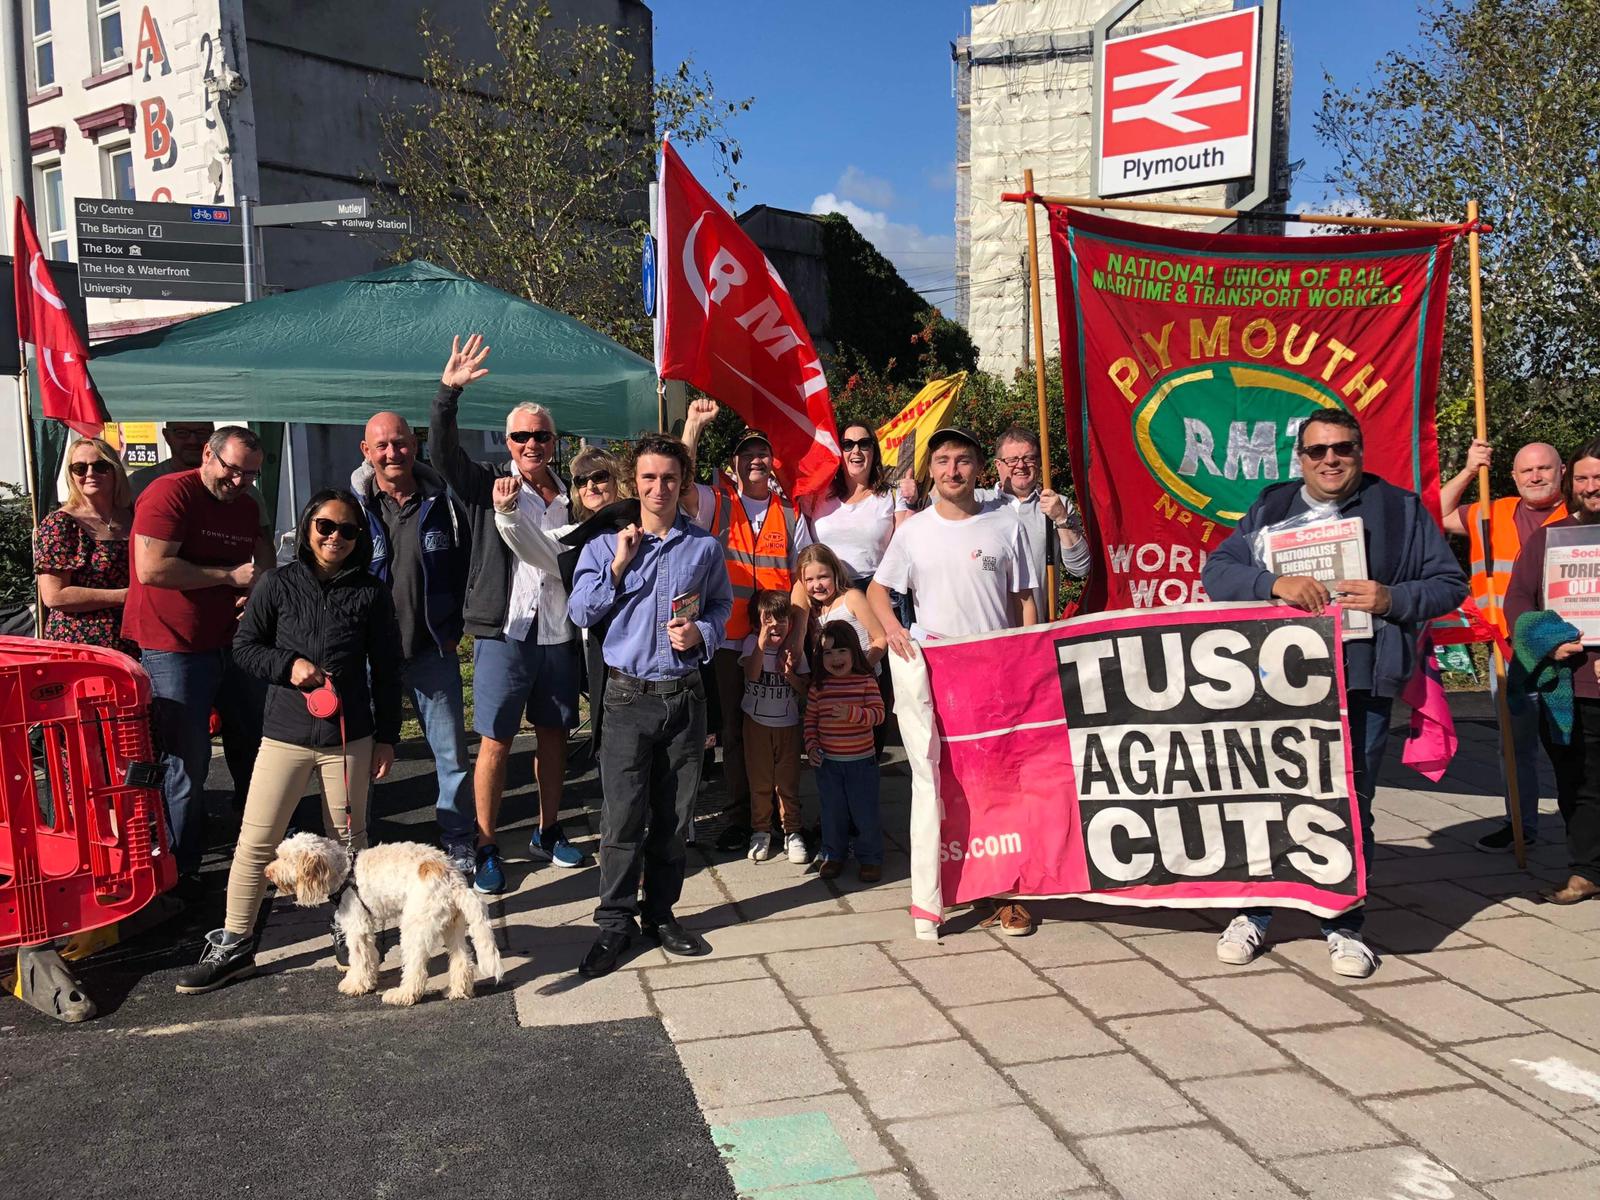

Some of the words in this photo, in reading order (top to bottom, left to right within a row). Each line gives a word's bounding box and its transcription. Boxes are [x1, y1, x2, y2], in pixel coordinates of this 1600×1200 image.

[1123, 147, 1224, 180] Plymouth
[78, 203, 98, 214] City
[101, 204, 134, 215] Centre
[338, 203, 362, 215] Mutley
[80, 222, 99, 233] The
[102, 223, 143, 236] Barbican
[342, 219, 374, 229] Railway
[377, 219, 407, 229] Station
[82, 242, 102, 253] The
[105, 244, 123, 254] Box
[82, 262, 101, 273] The
[104, 264, 124, 274] Hoe
[127, 264, 135, 274] &
[137, 265, 190, 277] Waterfront
[1107, 253, 1215, 286] NATIONAL
[1223, 266, 1291, 288] UNION
[1300, 267, 1330, 287] OF
[1338, 266, 1385, 287] RAIL
[84, 283, 132, 295] University
[1093, 269, 1171, 302] MARITIME
[1175, 284, 1188, 303] &
[1193, 284, 1302, 307] TRANSPORT
[1308, 284, 1403, 307] WORKERS
[1108, 316, 1388, 412] PLYMOUTH
[137, 450, 146, 462] 25
[147, 450, 156, 462] 25
[1201, 521, 1216, 543] 1
[1295, 521, 1358, 542] Socialist
[1107, 543, 1207, 573] WOR
[1276, 543, 1337, 563] NATIONALISE
[1281, 559, 1317, 574] ENERGY
[1318, 556, 1333, 569] TO
[1313, 568, 1336, 581] OUR
[1568, 577, 1598, 595] OUT
[1057, 625, 1332, 715] TUSC
[39, 683, 65, 698] JSP
[1080, 726, 1341, 796] AGAINST
[941, 832, 1022, 862] ss.com
[1086, 802, 1353, 886] CUTS
